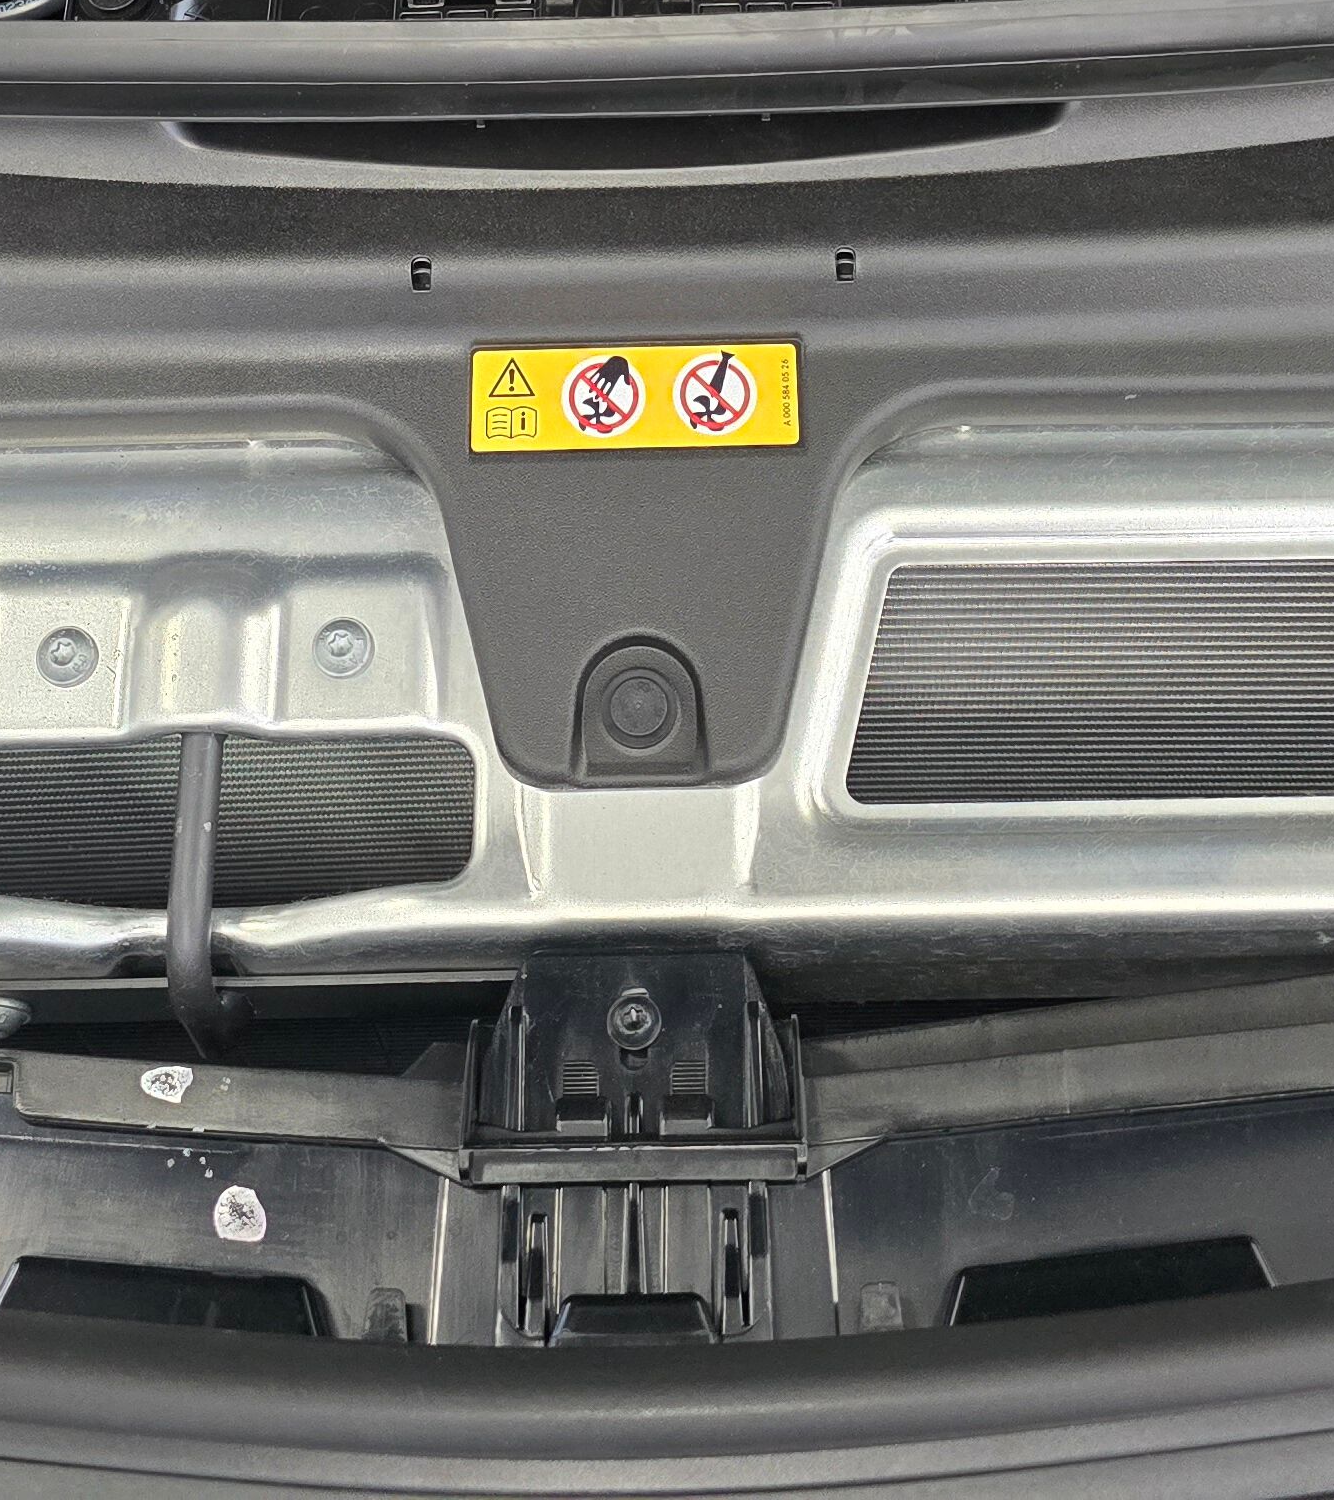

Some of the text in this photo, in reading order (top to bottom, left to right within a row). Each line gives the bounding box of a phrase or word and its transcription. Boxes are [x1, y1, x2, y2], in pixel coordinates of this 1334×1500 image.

[780, 358, 789, 369] 26
[781, 371, 789, 382] 05
[782, 384, 790, 399] 584
[782, 402, 791, 418] 000
